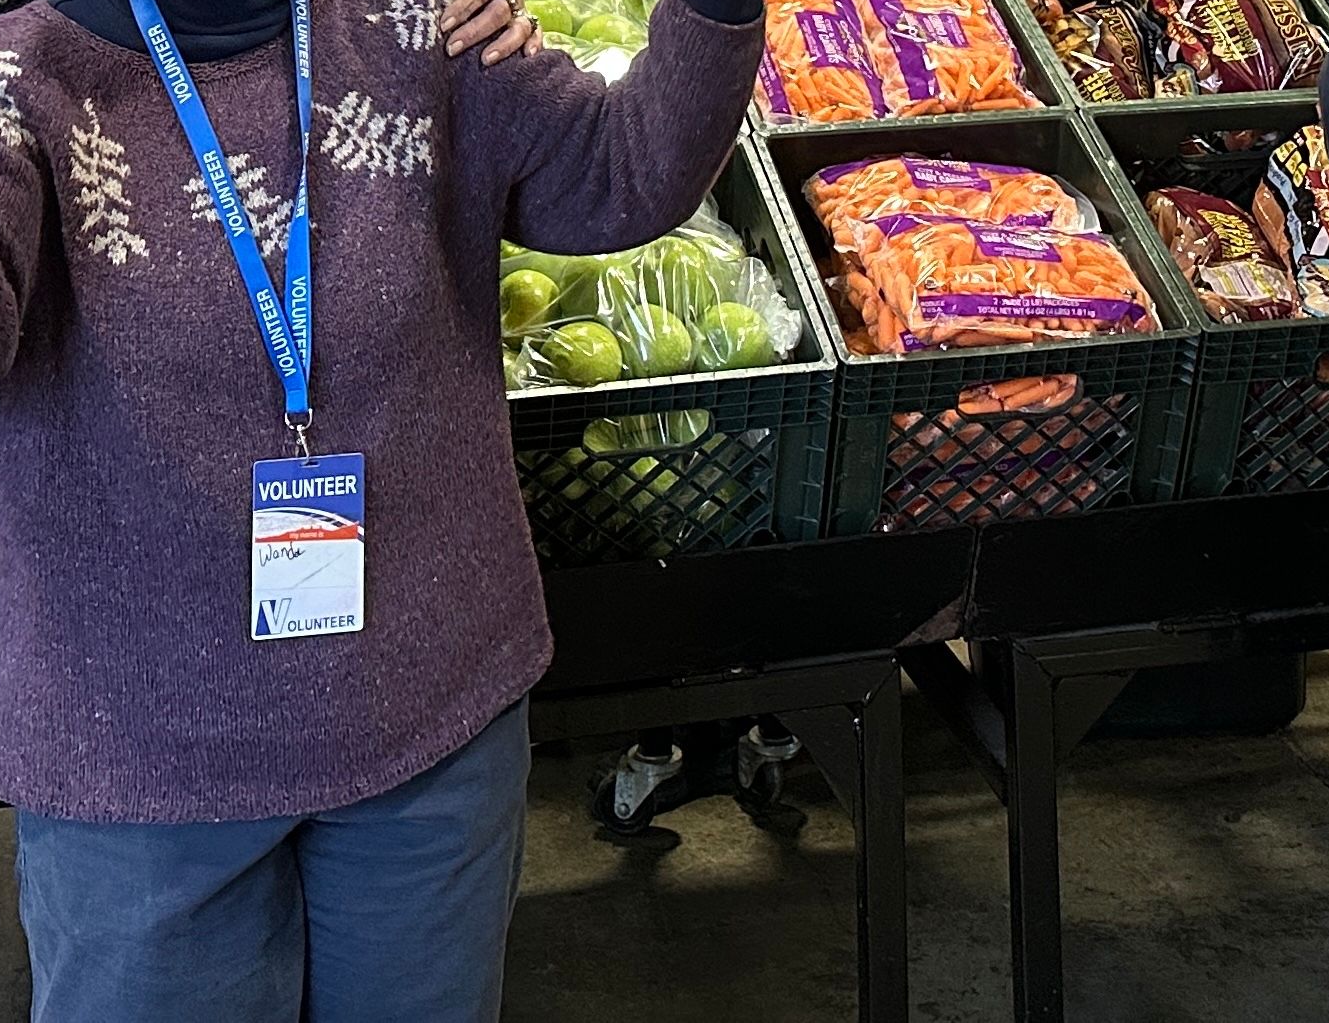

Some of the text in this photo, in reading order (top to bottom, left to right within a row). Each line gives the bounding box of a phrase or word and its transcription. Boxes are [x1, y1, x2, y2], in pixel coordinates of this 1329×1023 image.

[147, 24, 193, 104] VOLUNTEER
[202, 149, 246, 237] VOLUNTEER
[256, 288, 297, 377] VOLUNTEER
[258, 475, 358, 502] VOLUNTEER
